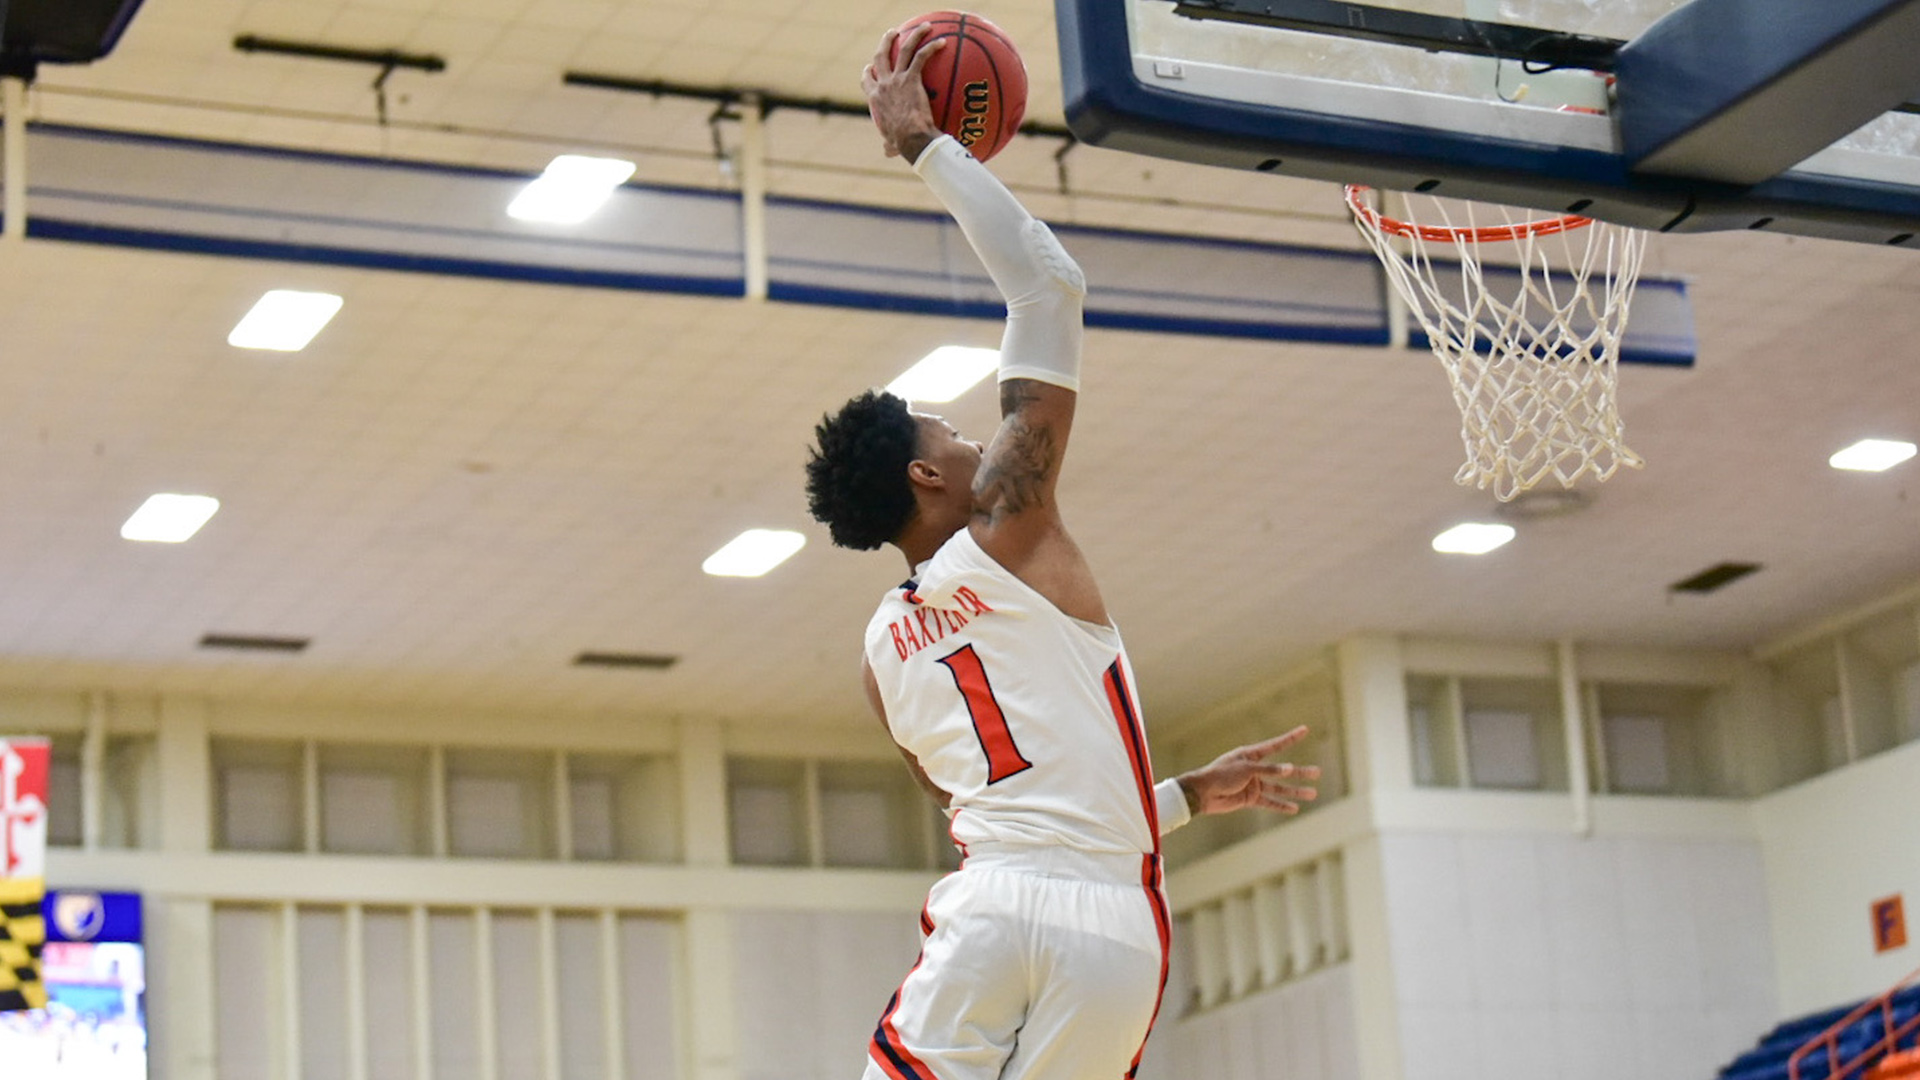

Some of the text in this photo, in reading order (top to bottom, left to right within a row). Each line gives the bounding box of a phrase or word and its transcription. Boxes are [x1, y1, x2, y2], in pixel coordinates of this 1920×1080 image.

[958, 79, 989, 148] Wils
[934, 642, 1033, 786] 1
[1877, 902, 1898, 946] F
